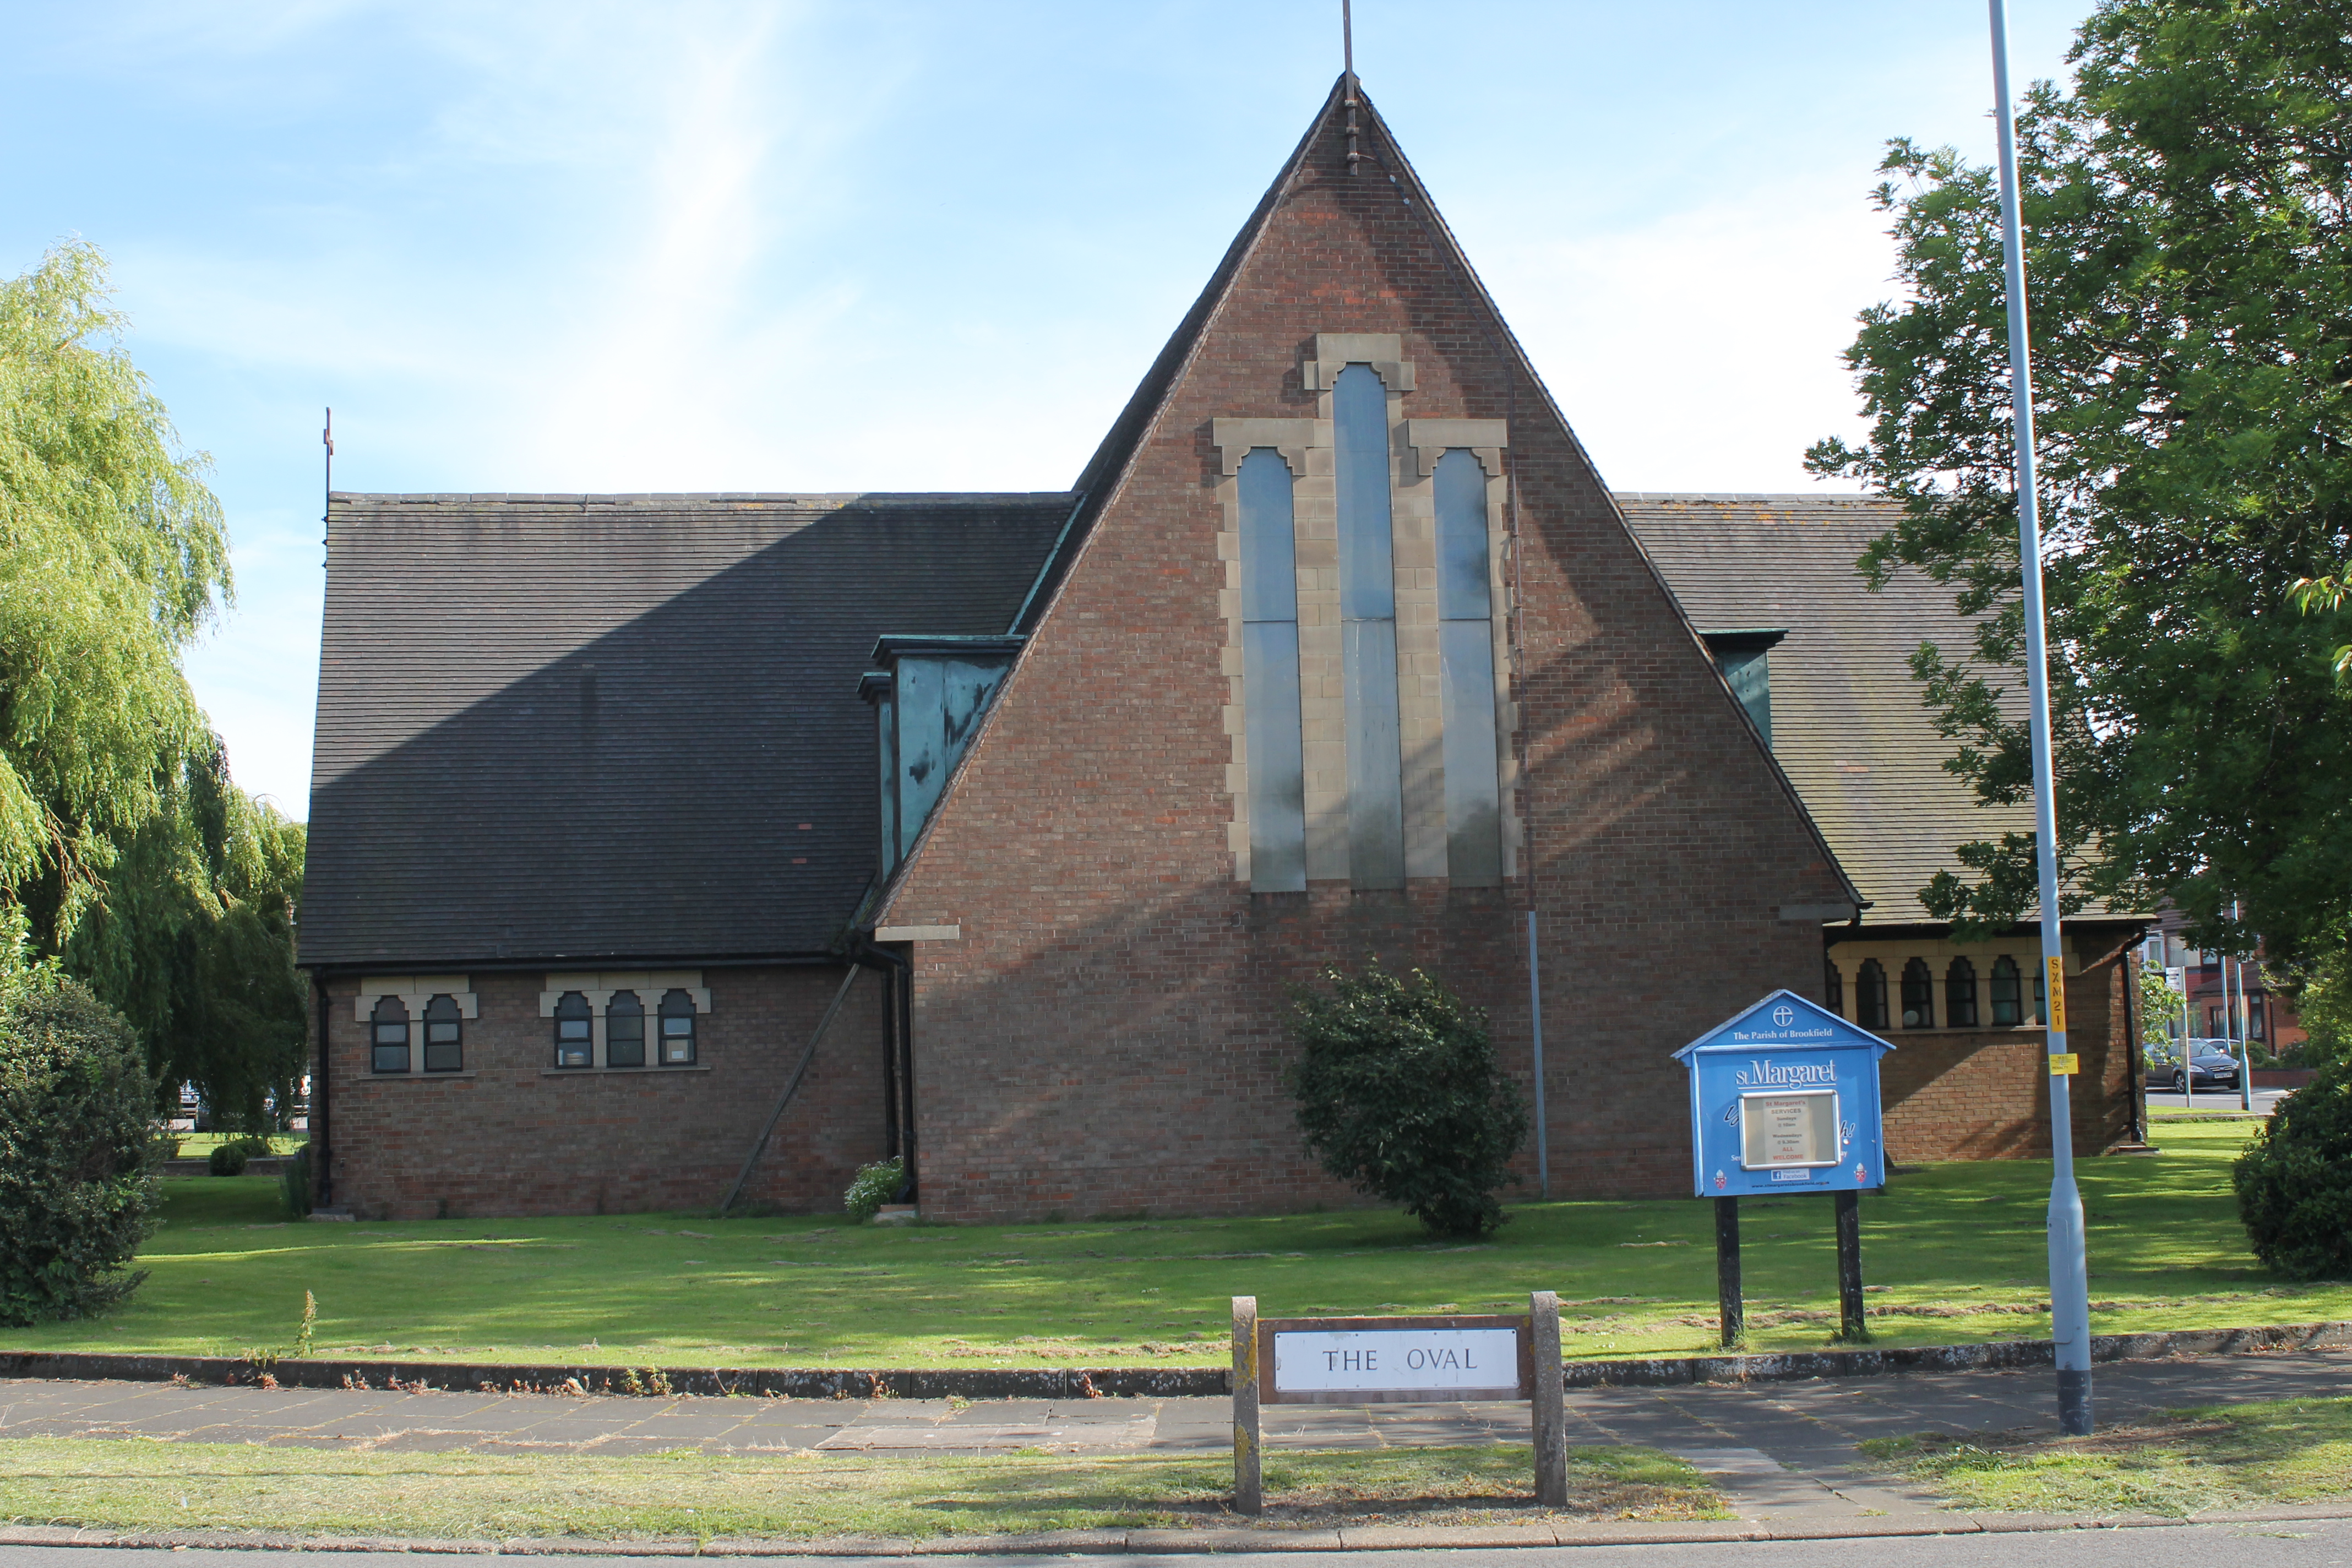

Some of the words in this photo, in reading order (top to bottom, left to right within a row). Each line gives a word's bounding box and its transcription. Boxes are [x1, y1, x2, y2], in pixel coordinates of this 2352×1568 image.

[1733, 1032, 1750, 1040] The
[1751, 1031, 1777, 1039] Parish
[1779, 1030, 1789, 1038] of
[1790, 1028, 1832, 1038] Brookfield
[1736, 1070, 1749, 1085] St
[1750, 1059, 1837, 1090] Margaret
[1322, 1350, 1378, 1371] THE
[1407, 1348, 1478, 1370] OVAL
